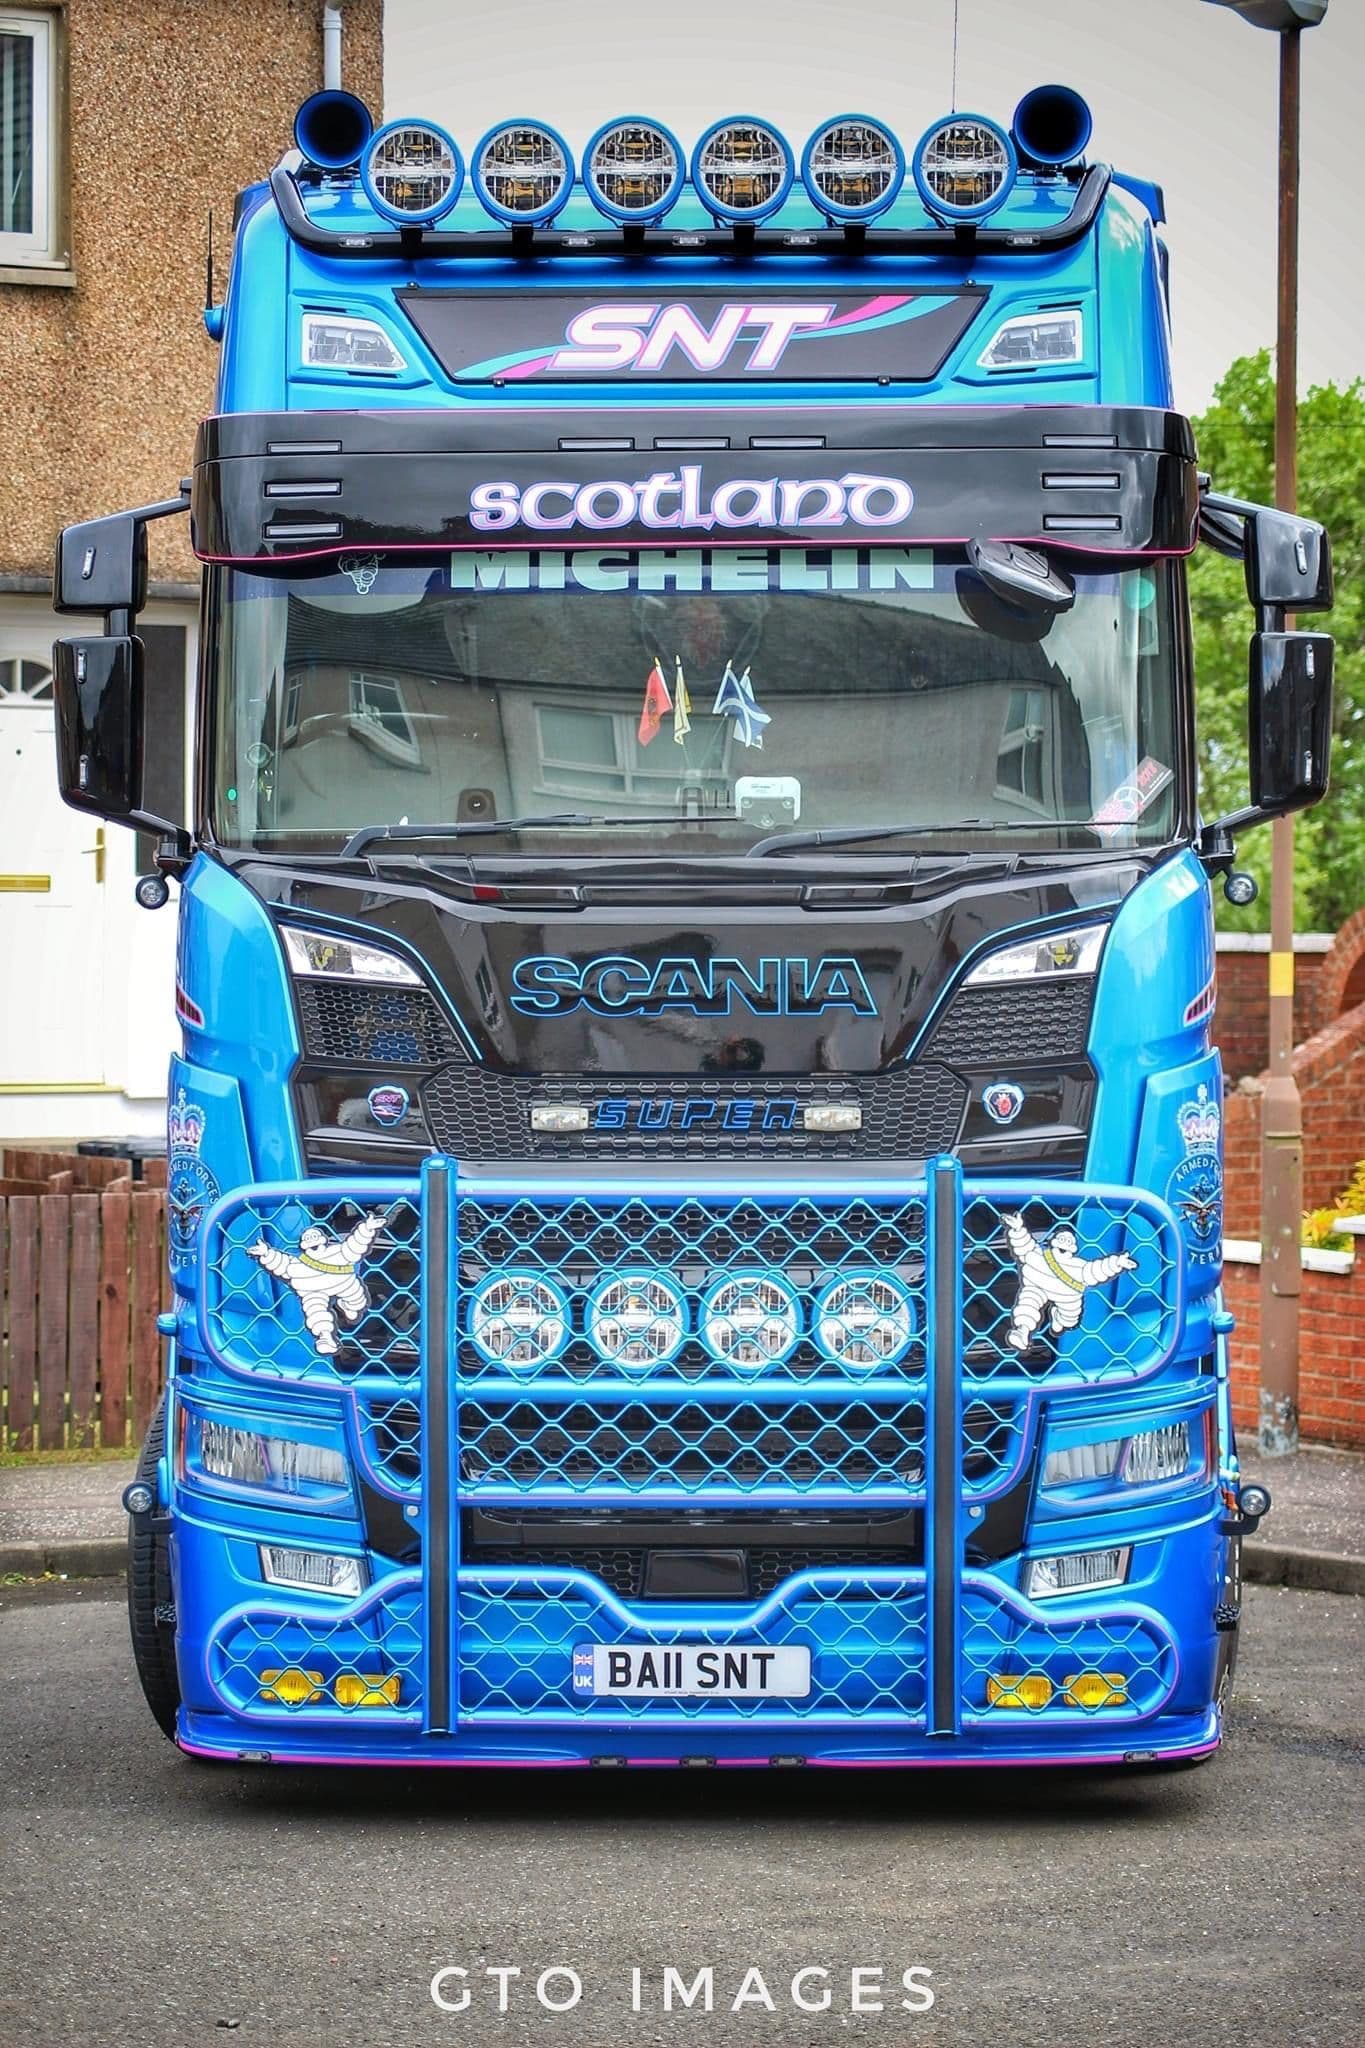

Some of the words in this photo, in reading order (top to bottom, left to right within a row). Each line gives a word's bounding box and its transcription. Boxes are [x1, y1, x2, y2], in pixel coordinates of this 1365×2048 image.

[545, 304, 837, 371] SNT
[450, 548, 934, 591] MICHELIN
[510, 956, 879, 1017] SCANIA
[374, 1094, 402, 1103] SNT
[594, 1099, 798, 1129] SUPER
[189, 1162, 219, 1205] FORCES
[1175, 1157, 1209, 1183] ARMED
[575, 1675, 593, 1688] UK
[696, 1653, 775, 1689] SNT
